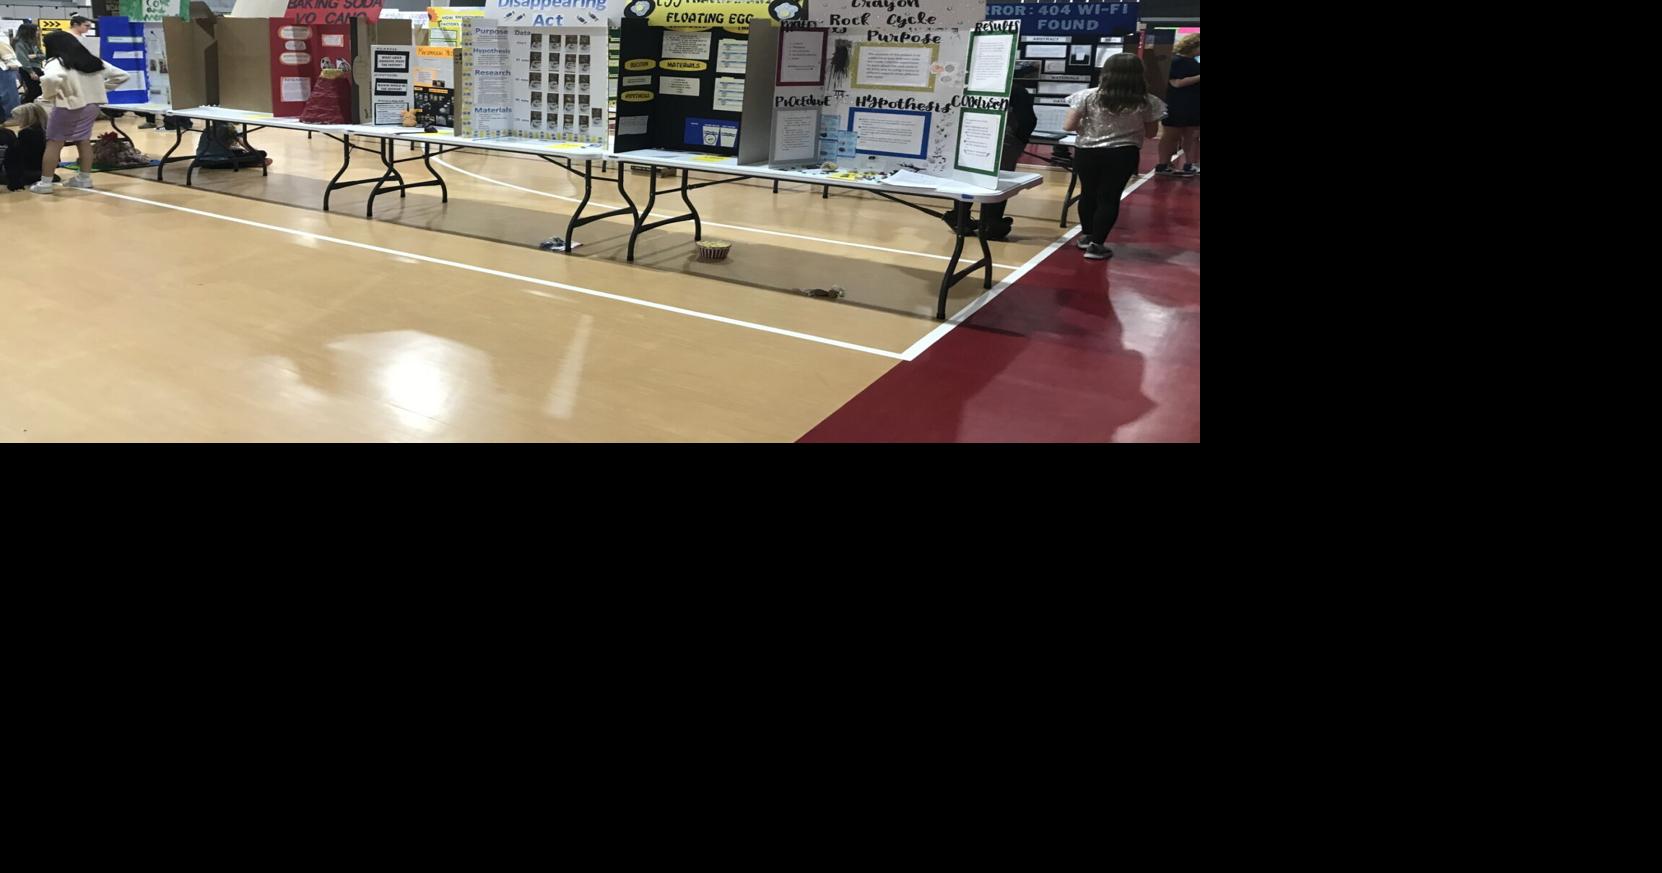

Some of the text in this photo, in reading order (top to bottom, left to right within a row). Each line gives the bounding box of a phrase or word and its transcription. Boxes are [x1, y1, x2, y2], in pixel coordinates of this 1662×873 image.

[498, 0, 607, 10] Disappearing
[851, 0, 920, 12] Crayon
[986, 5, 1034, 15] ROR:
[1038, 5, 1072, 15] 404
[532, 14, 564, 26] Act
[666, 12, 724, 24] FLOATING
[829, 12, 937, 28] Rock Cycle
[1037, 19, 1100, 30] FOUND
[475, 27, 508, 36] Purpose
[867, 30, 942, 44] Purpose
[473, 47, 511, 55] Hypothesis
[855, 95, 951, 113] Hypothesis
[474, 106, 513, 114] Materials
